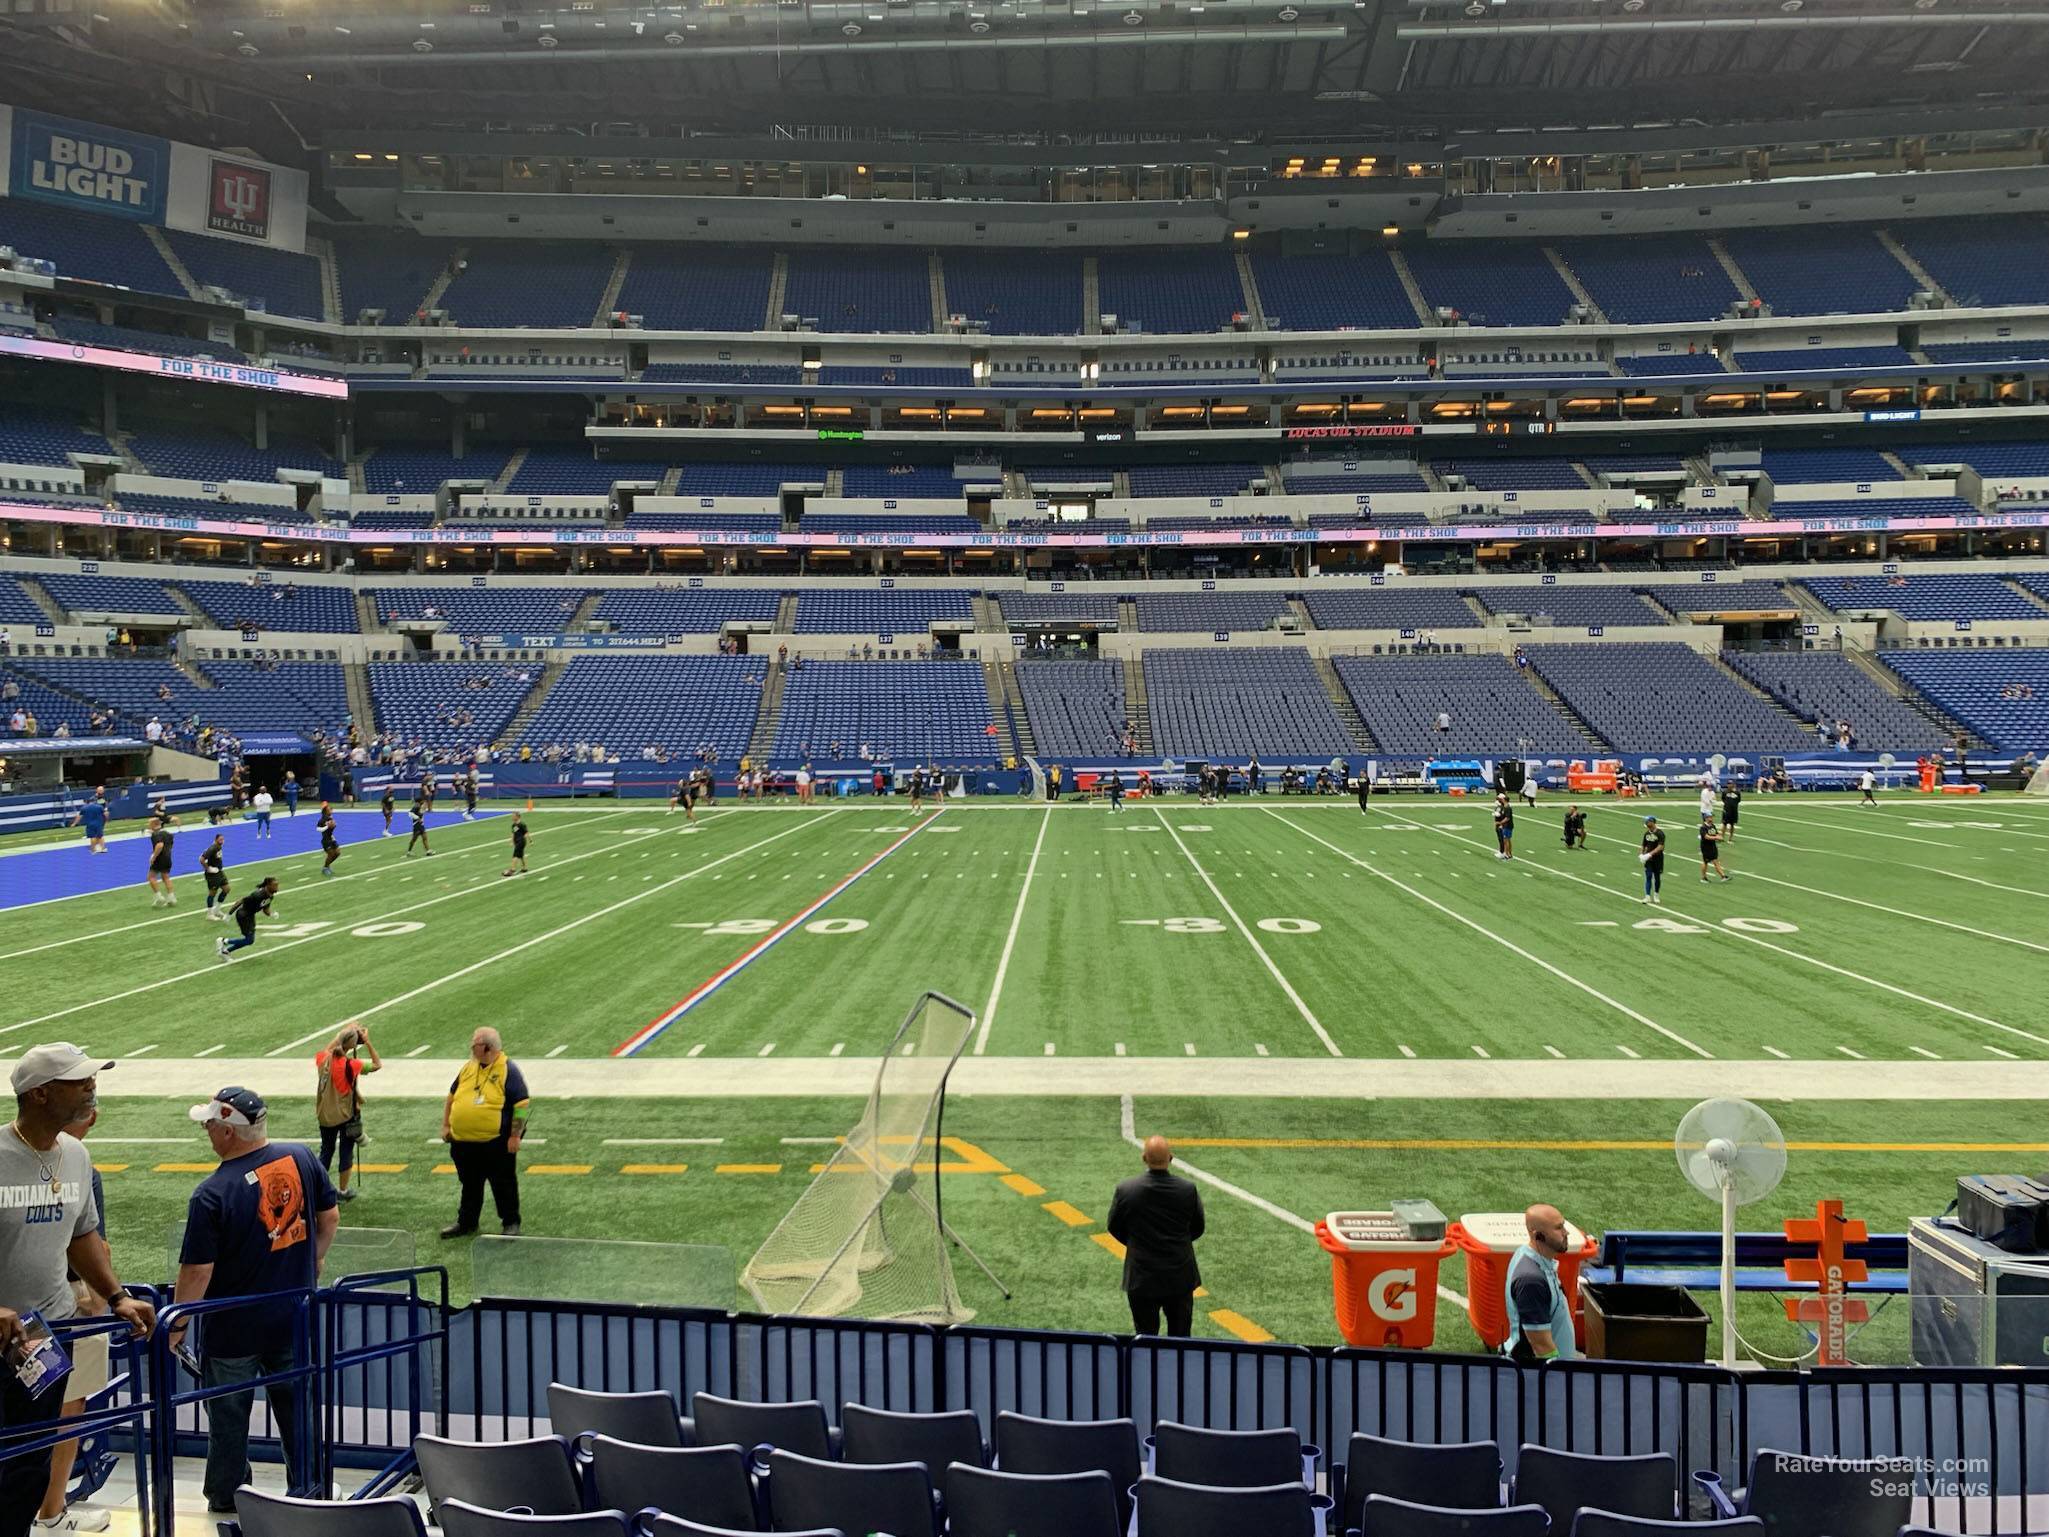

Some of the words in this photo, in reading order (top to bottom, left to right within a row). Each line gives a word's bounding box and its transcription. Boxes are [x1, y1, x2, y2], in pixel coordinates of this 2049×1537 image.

[51, 136, 134, 176] BUD
[32, 160, 148, 206] LIGHT
[212, 216, 264, 237] HEALTH
[161, 359, 193, 374] FOR
[200, 364, 232, 379] THE
[237, 370, 279, 386] SHOE
[1288, 427, 1328, 438] LUCAS
[1330, 426, 1352, 437] OIL
[1354, 424, 1415, 436] STADIUM
[1528, 423, 1545, 433] QTR
[1096, 433, 1121, 441] verizon
[102, 513, 128, 524] FOR
[133, 516, 160, 526] THE
[164, 518, 199, 529] SHOE
[1803, 520, 1826, 530] FOR
[1830, 519, 1854, 529] THE
[1856, 519, 1888, 529] SHOE
[1955, 516, 1978, 526] FOR
[1983, 515, 2007, 525] THE
[2011, 515, 2043, 525] SHOE
[268, 527, 289, 536] FOR
[295, 528, 318, 538] THE
[321, 530, 350, 540] SHOE
[1379, 529, 1400, 538] FOR
[1404, 528, 1426, 538] THE
[1429, 528, 1458, 537] SHOE
[1517, 526, 1538, 536] FOR
[1541, 526, 1565, 535] THE
[1567, 526, 1596, 535] SHOE
[1657, 524, 1680, 534] FOR
[1683, 524, 1707, 533] THE
[1710, 523, 1739, 533] SHOE
[412, 532, 433, 541] FOR
[438, 532, 461, 541] THE
[464, 532, 494, 541] SHOE
[556, 532, 578, 541] FOR
[583, 532, 605, 541] THE
[608, 532, 637, 541] SHOE
[698, 534, 719, 543] FOR
[723, 534, 746, 543] THE
[749, 534, 777, 543] SHOE
[838, 535, 858, 544] FOR
[863, 535, 884, 544] THE
[887, 535, 915, 544] SHOE
[972, 535, 993, 544] FOR
[996, 535, 1018, 544] THE
[1020, 535, 1048, 544] SHOE
[1106, 535, 1128, 544] FOR
[1131, 534, 1153, 543] THE
[1155, 534, 1183, 543] SHOE
[1242, 531, 1262, 541] FOR
[1266, 531, 1288, 541] THE
[1290, 530, 1319, 540] SHOE
[522, 636, 556, 647] TEXT
[261, 921, 426, 937] 10
[702, 918, 869, 935] 20
[1164, 917, 1322, 933] 30
[1632, 917, 1799, 933] 40
[25, 1202, 63, 1224] COLTS
[1368, 1268, 1417, 1321] G
[1827, 1265, 1845, 1361] GATORADE
